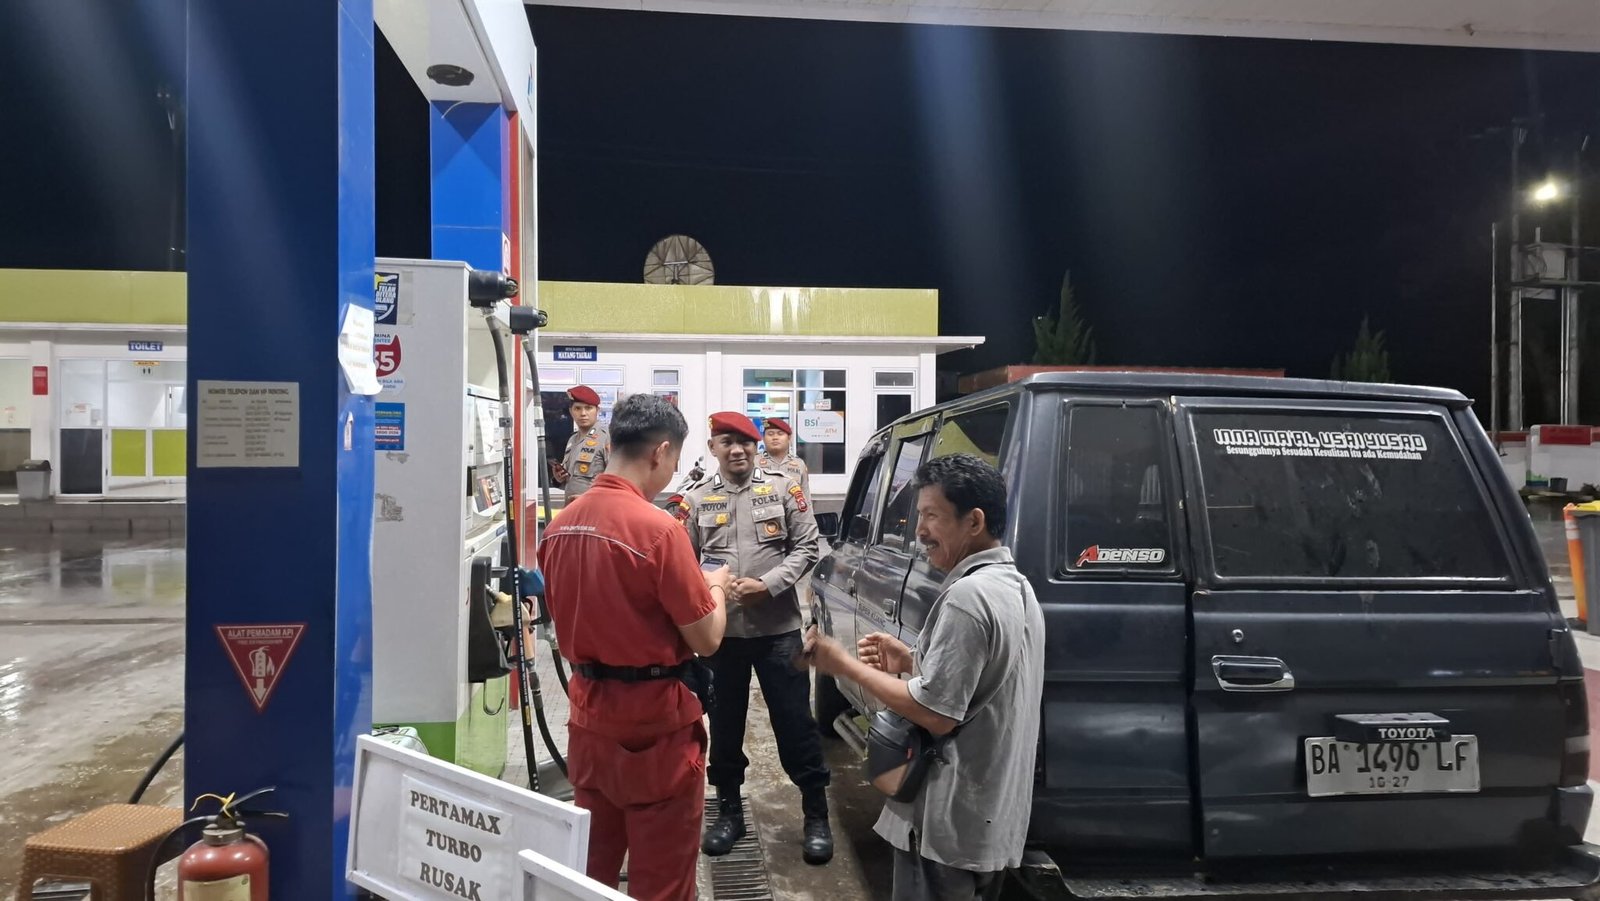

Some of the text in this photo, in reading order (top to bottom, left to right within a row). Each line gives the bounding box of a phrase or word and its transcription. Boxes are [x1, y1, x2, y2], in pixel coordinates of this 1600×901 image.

[130, 342, 161, 350] TOILET
[804, 418, 818, 427] BSI
[1226, 445, 1422, 460] Sesungguhnya Sesudah Kesulitan itu ada Kemudahan
[752, 494, 779, 506] POLRI
[227, 628, 293, 638] ALAT PEMADAM API
[1378, 727, 1436, 739] TOYOTA
[1311, 743, 1341, 775] BA
[410, 790, 501, 835] PERTAMAX
[426, 829, 482, 863] TURBO
[420, 861, 482, 901] RUSAK
